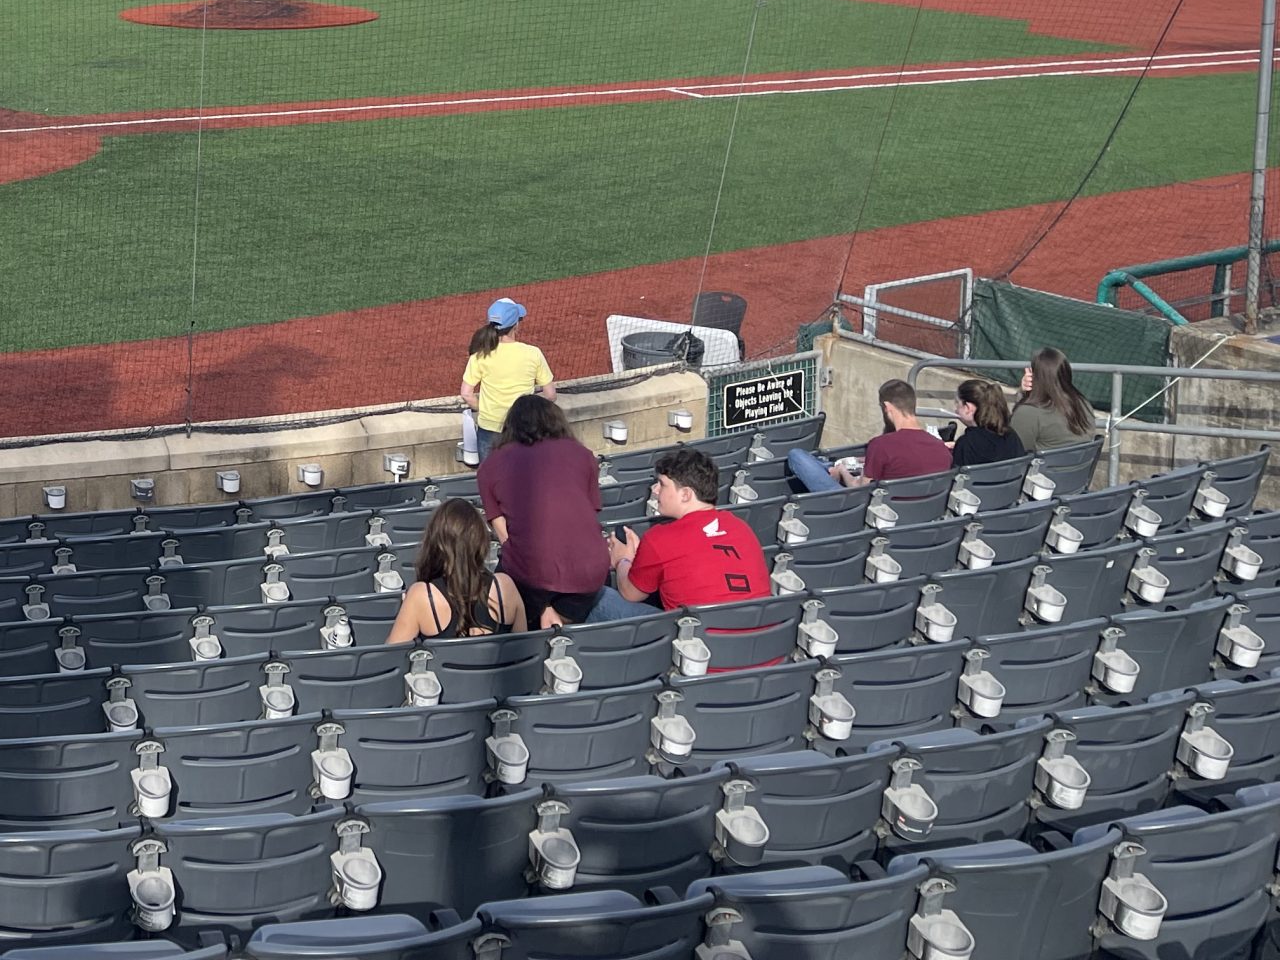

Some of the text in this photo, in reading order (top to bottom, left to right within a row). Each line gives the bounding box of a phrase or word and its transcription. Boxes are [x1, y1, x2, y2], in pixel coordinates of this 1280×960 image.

[735, 376, 793, 398] Please Be Aware of
[734, 395, 757, 410] Objects
[759, 391, 782, 405] Leaving
[744, 401, 785, 419] Playing Field
